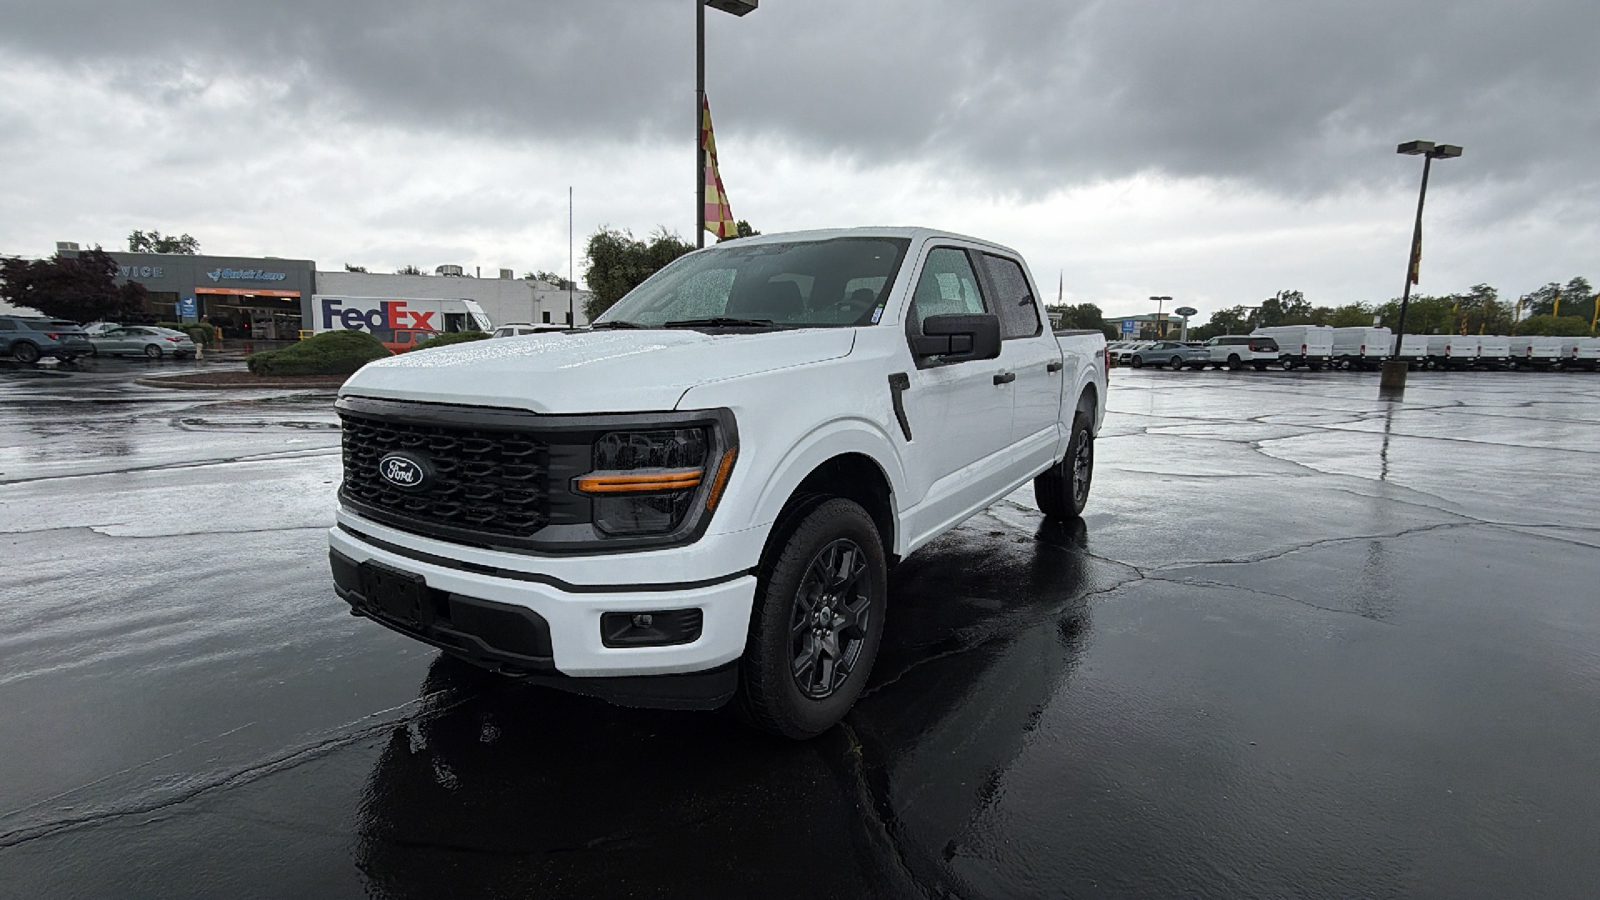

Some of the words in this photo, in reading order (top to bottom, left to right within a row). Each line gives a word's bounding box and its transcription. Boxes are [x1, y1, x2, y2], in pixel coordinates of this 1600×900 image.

[221, 268, 256, 279] Quick
[256, 269, 286, 280] Lane
[321, 299, 435, 330] FedEx
[387, 460, 414, 482] Ford
